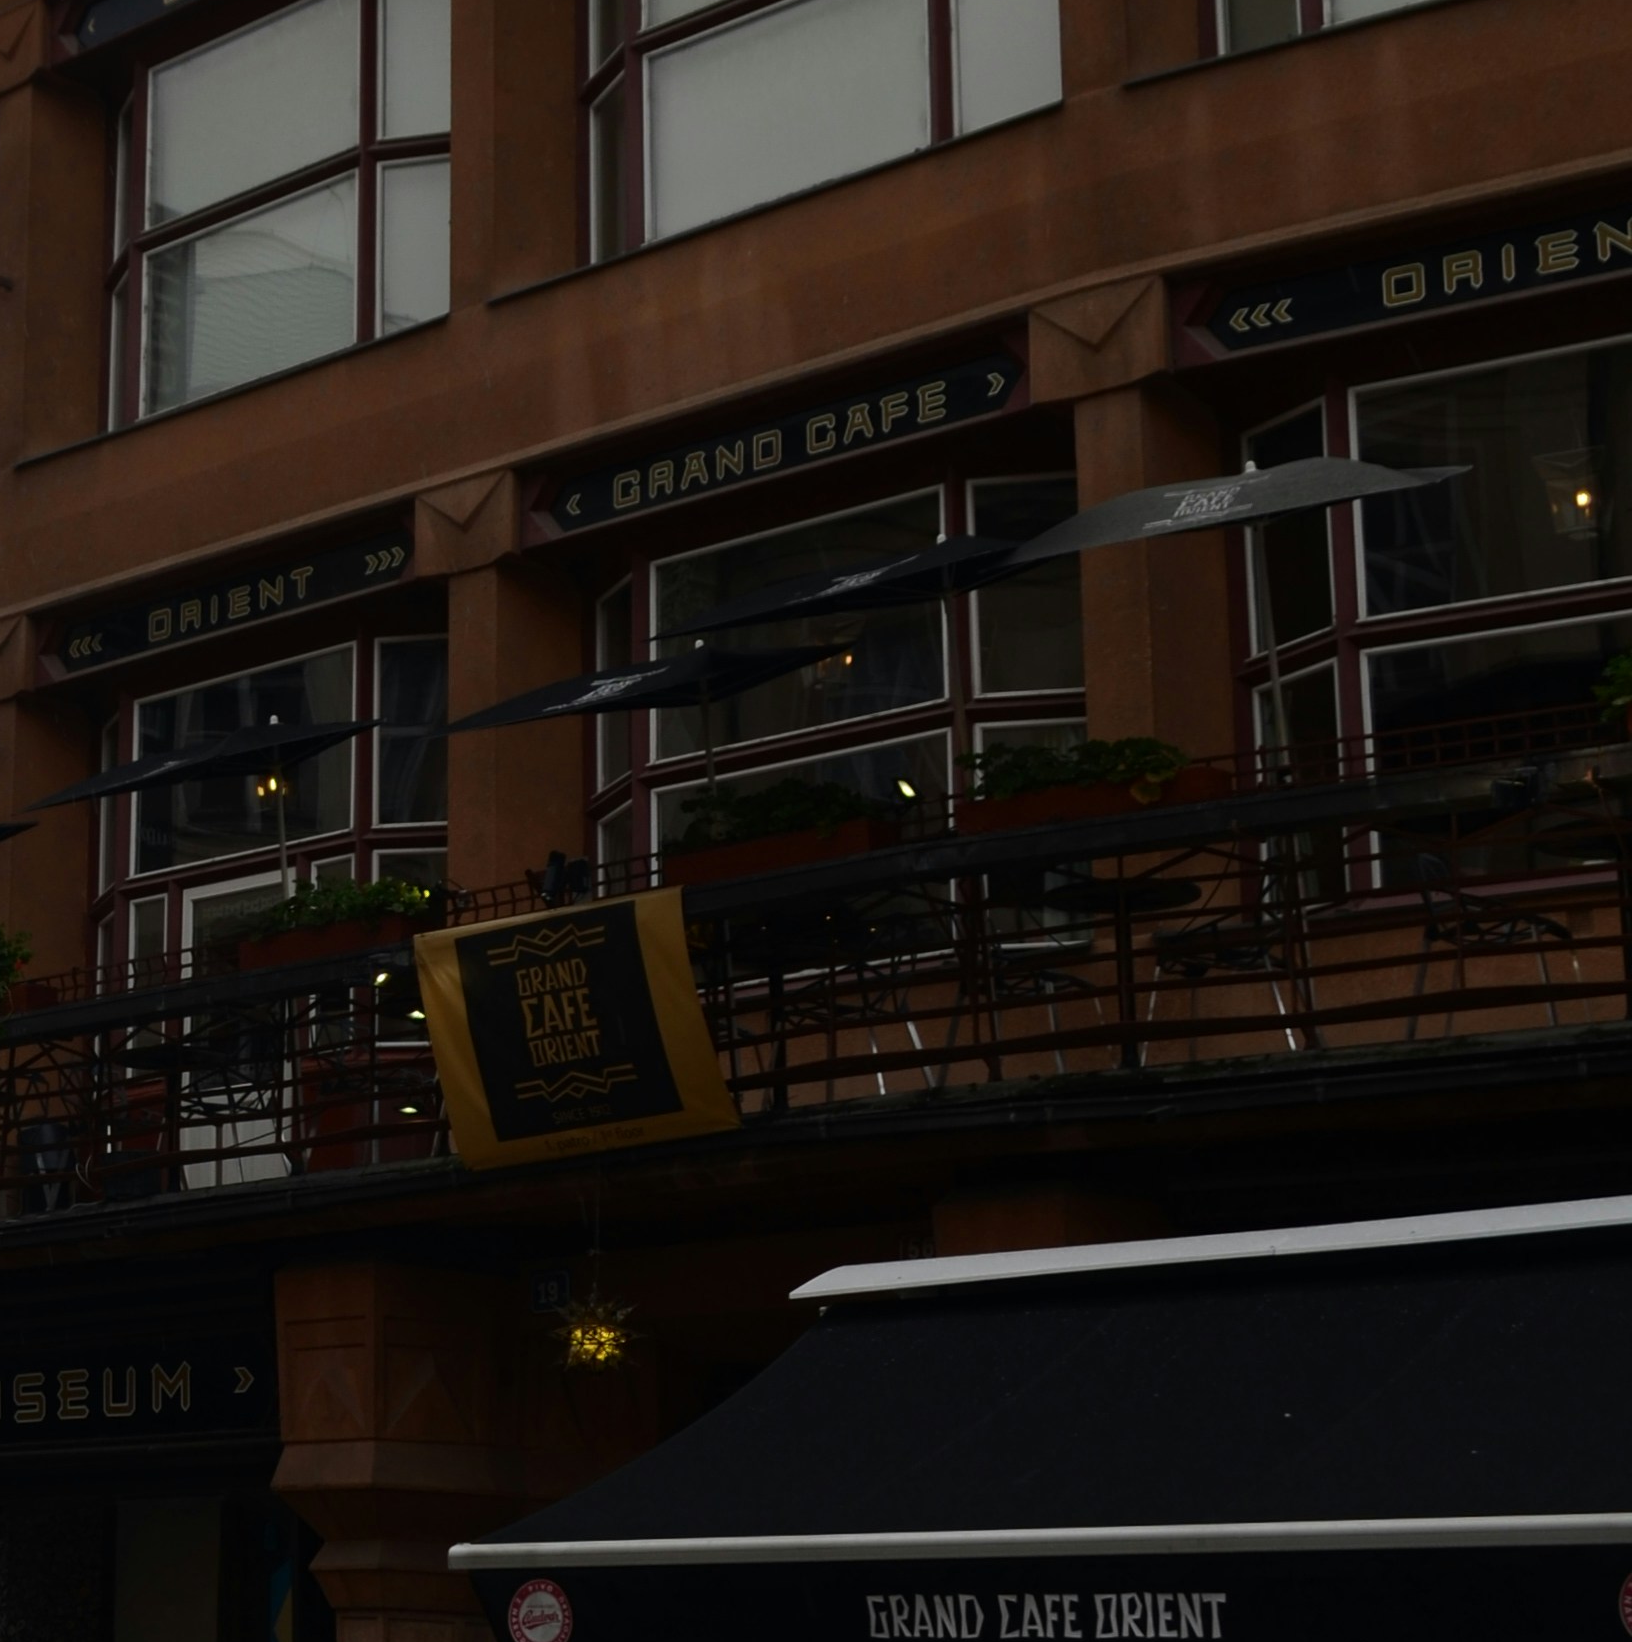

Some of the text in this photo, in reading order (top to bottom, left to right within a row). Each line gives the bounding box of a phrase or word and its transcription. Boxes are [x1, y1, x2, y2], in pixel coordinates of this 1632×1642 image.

[1381, 216, 1632, 308] ORIEN
[612, 380, 947, 510] GRAND CAFE
[148, 565, 314, 643] ORIENT
[516, 957, 587, 997] GRAND
[521, 987, 598, 1039] CAFE
[529, 1029, 601, 1068] ORIENT
[552, 1107, 587, 1125] SINCE
[537, 1281, 558, 1303] 19
[866, 1591, 1227, 1639] GRAND CAFE ORIENT
